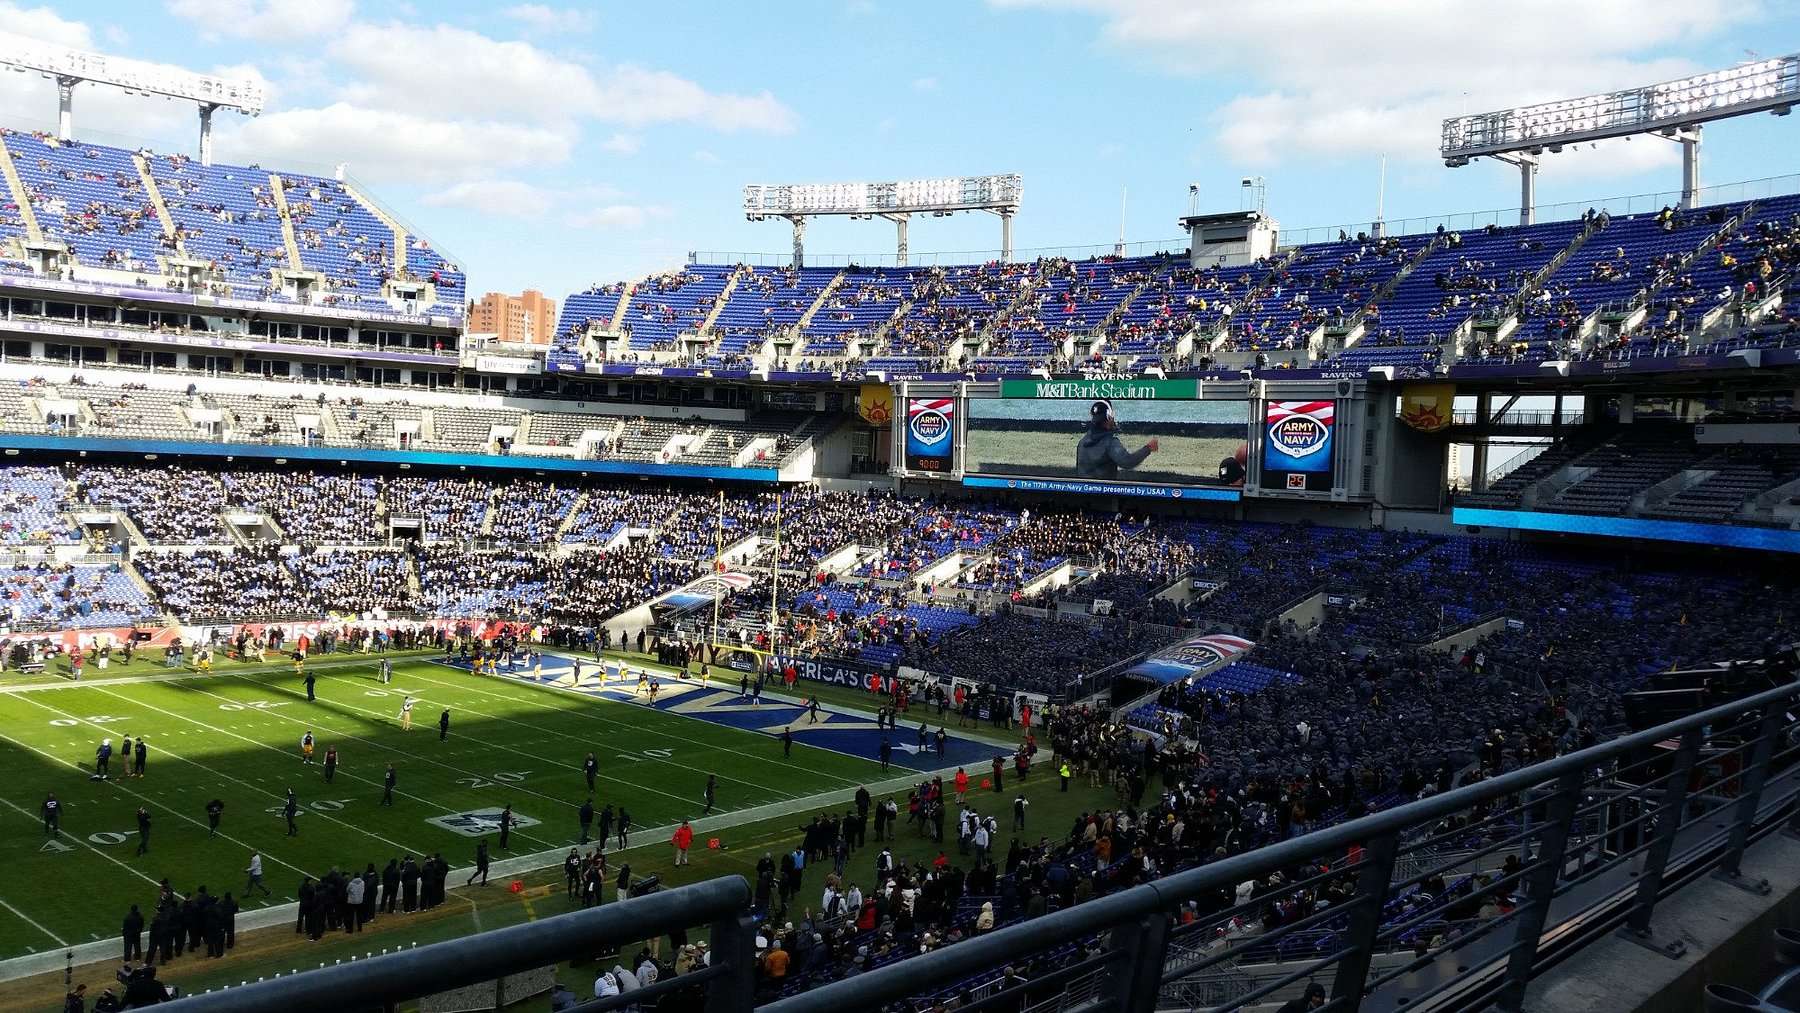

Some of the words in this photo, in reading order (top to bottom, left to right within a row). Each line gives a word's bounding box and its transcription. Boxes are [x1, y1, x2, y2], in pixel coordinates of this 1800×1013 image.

[1084, 373, 1133, 381] RAVENS
[1320, 371, 1363, 379] RAVENS
[1036, 382, 1068, 398] M&T
[1069, 382, 1100, 399] Bank
[1101, 382, 1156, 399] Stadium
[920, 416, 940, 424] ARMY
[1283, 422, 1314, 431] ARMY
[1284, 436, 1313, 445] NAVY
[1048, 483, 1083, 492] Army-Navy
[1083, 484, 1102, 492] Game
[1103, 486, 1135, 495] presented
[1136, 487, 1145, 496] by
[1146, 487, 1166, 496] USAA
[647, 635, 721, 665] AMY
[456, 772, 525, 789] 20
[40, 831, 129, 852] 40
